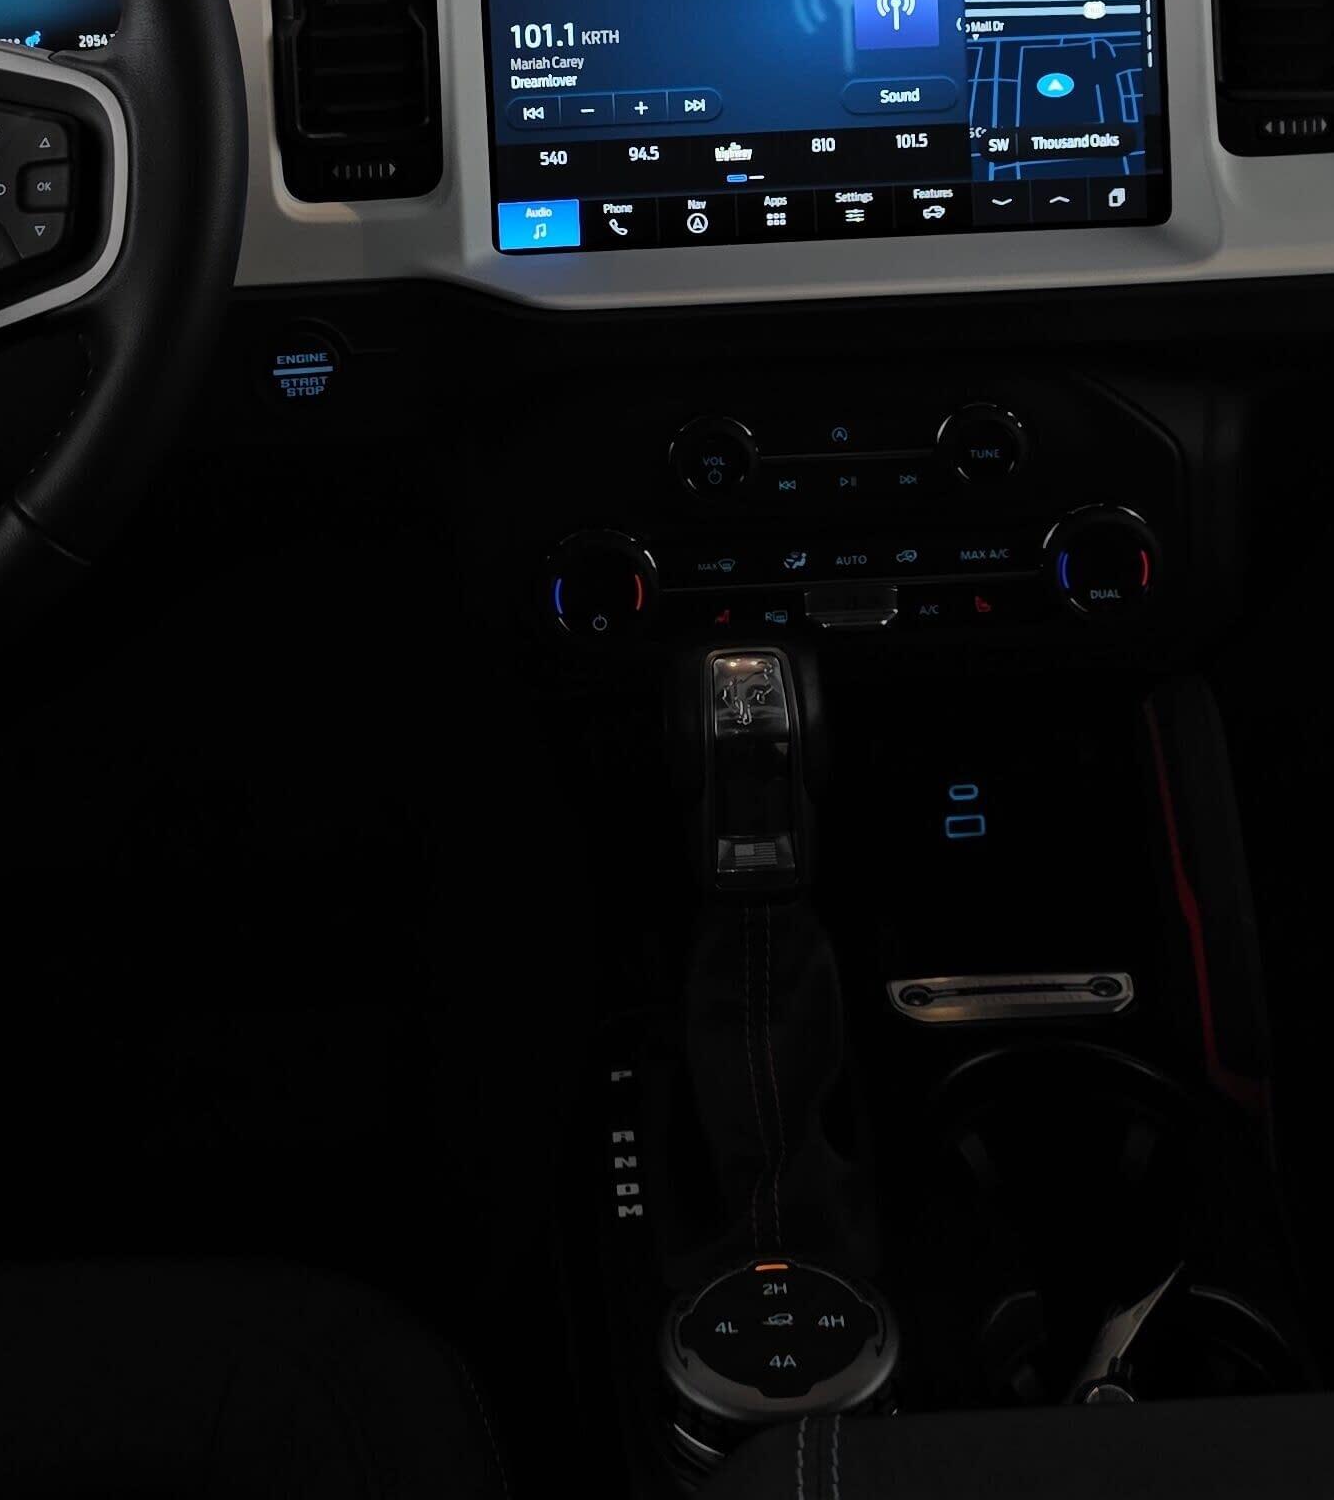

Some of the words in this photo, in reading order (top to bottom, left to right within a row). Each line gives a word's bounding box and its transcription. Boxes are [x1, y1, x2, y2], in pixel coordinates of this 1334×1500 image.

[993, 20, 1004, 32] Dr
[510, 22, 575, 49] 101.1
[581, 29, 619, 45] KRTH
[510, 57, 551, 71] Mariah
[551, 55, 584, 70] Carey
[510, 74, 578, 89] Dreamlover
[880, 88, 920, 104] Sound
[811, 137, 835, 152] 810
[895, 133, 928, 148] 101.5
[988, 138, 1009, 152] SW
[1030, 134, 1089, 150] Thousand
[1090, 133, 1120, 148] Oaks
[539, 150, 568, 166] 540
[628, 146, 660, 162] 94.5
[37, 181, 51, 192] OK
[835, 192, 873, 203] Settings
[913, 188, 953, 200] Features
[687, 199, 706, 210] Nav
[764, 196, 787, 207] Apps
[525, 207, 552, 218] Audio
[603, 203, 633, 214] Phone
[276, 352, 329, 365] ENGINE
[280, 376, 328, 388] START
[286, 385, 324, 397] STOP
[970, 448, 1001, 459] TUNE
[702, 456, 725, 467] VOL
[835, 555, 867, 566] AUTO
[959, 550, 987, 561] MAX
[989, 548, 1010, 560] A/C
[1090, 588, 1121, 600] DUAL
[919, 604, 939, 616] A/C
[614, 1155, 638, 1169] N
[618, 1204, 644, 1218] M
[763, 1282, 788, 1296] 2H
[715, 1320, 739, 1334] 4L
[817, 1314, 846, 1329] 4H
[768, 1354, 797, 1368] 4A
